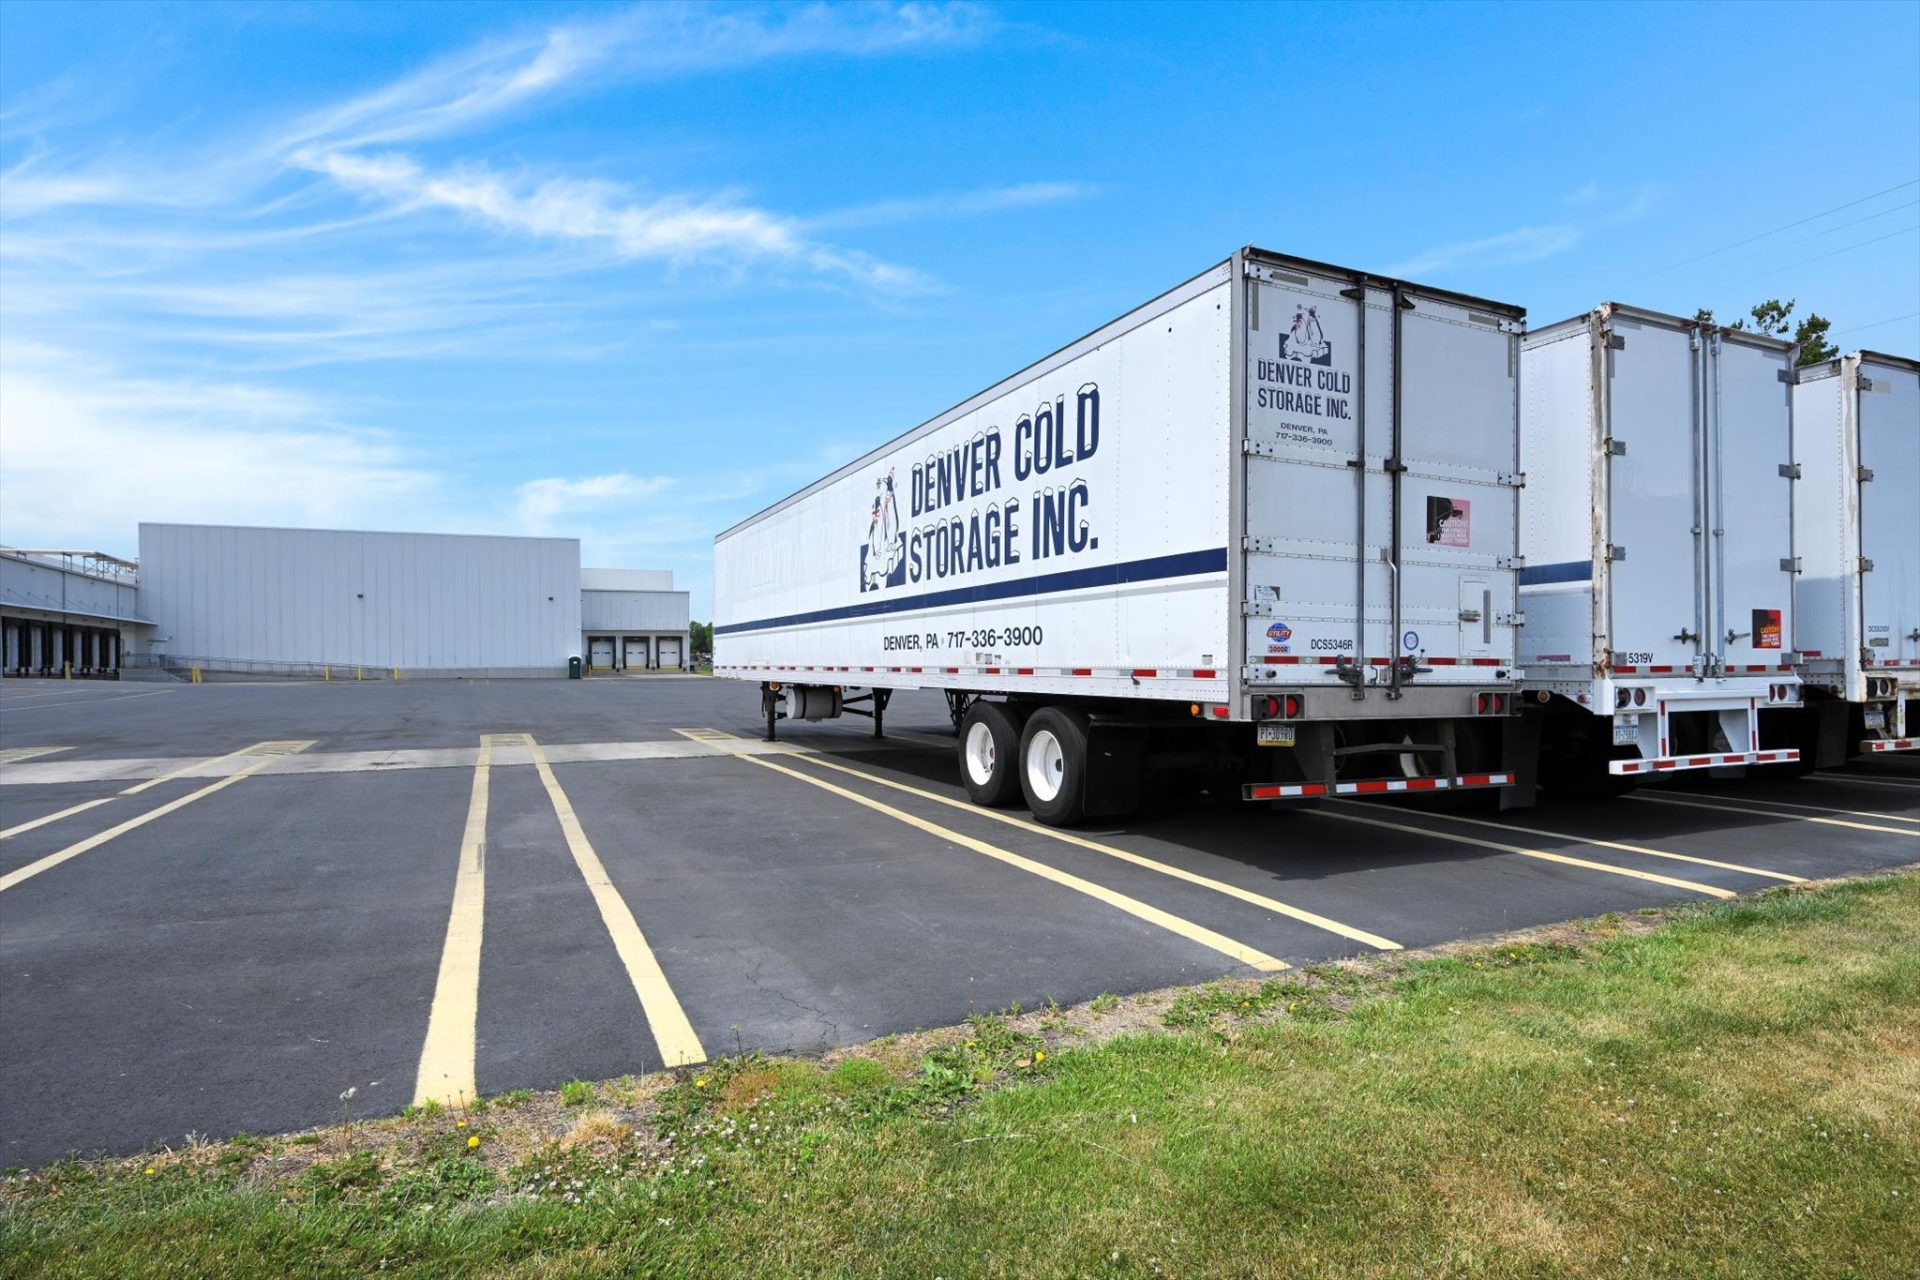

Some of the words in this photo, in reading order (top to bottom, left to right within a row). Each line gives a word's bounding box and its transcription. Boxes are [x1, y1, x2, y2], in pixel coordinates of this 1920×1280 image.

[1258, 359, 1312, 388] DENVER
[1318, 369, 1350, 394] COLD
[1257, 386, 1322, 416] STORAGE
[1326, 397, 1351, 420] INC.
[1275, 431, 1333, 446] 717-336-3900
[1318, 426, 1328, 435] PA
[911, 426, 1001, 518] DENVER
[1015, 382, 1100, 481] COLD
[909, 497, 1020, 583] STORAGE
[1032, 478, 1099, 561] INC.
[883, 634, 922, 652] DENVER,
[926, 633, 939, 649] PA
[947, 625, 1043, 648] 717-336-3900
[1310, 638, 1353, 650] DCS5346R
